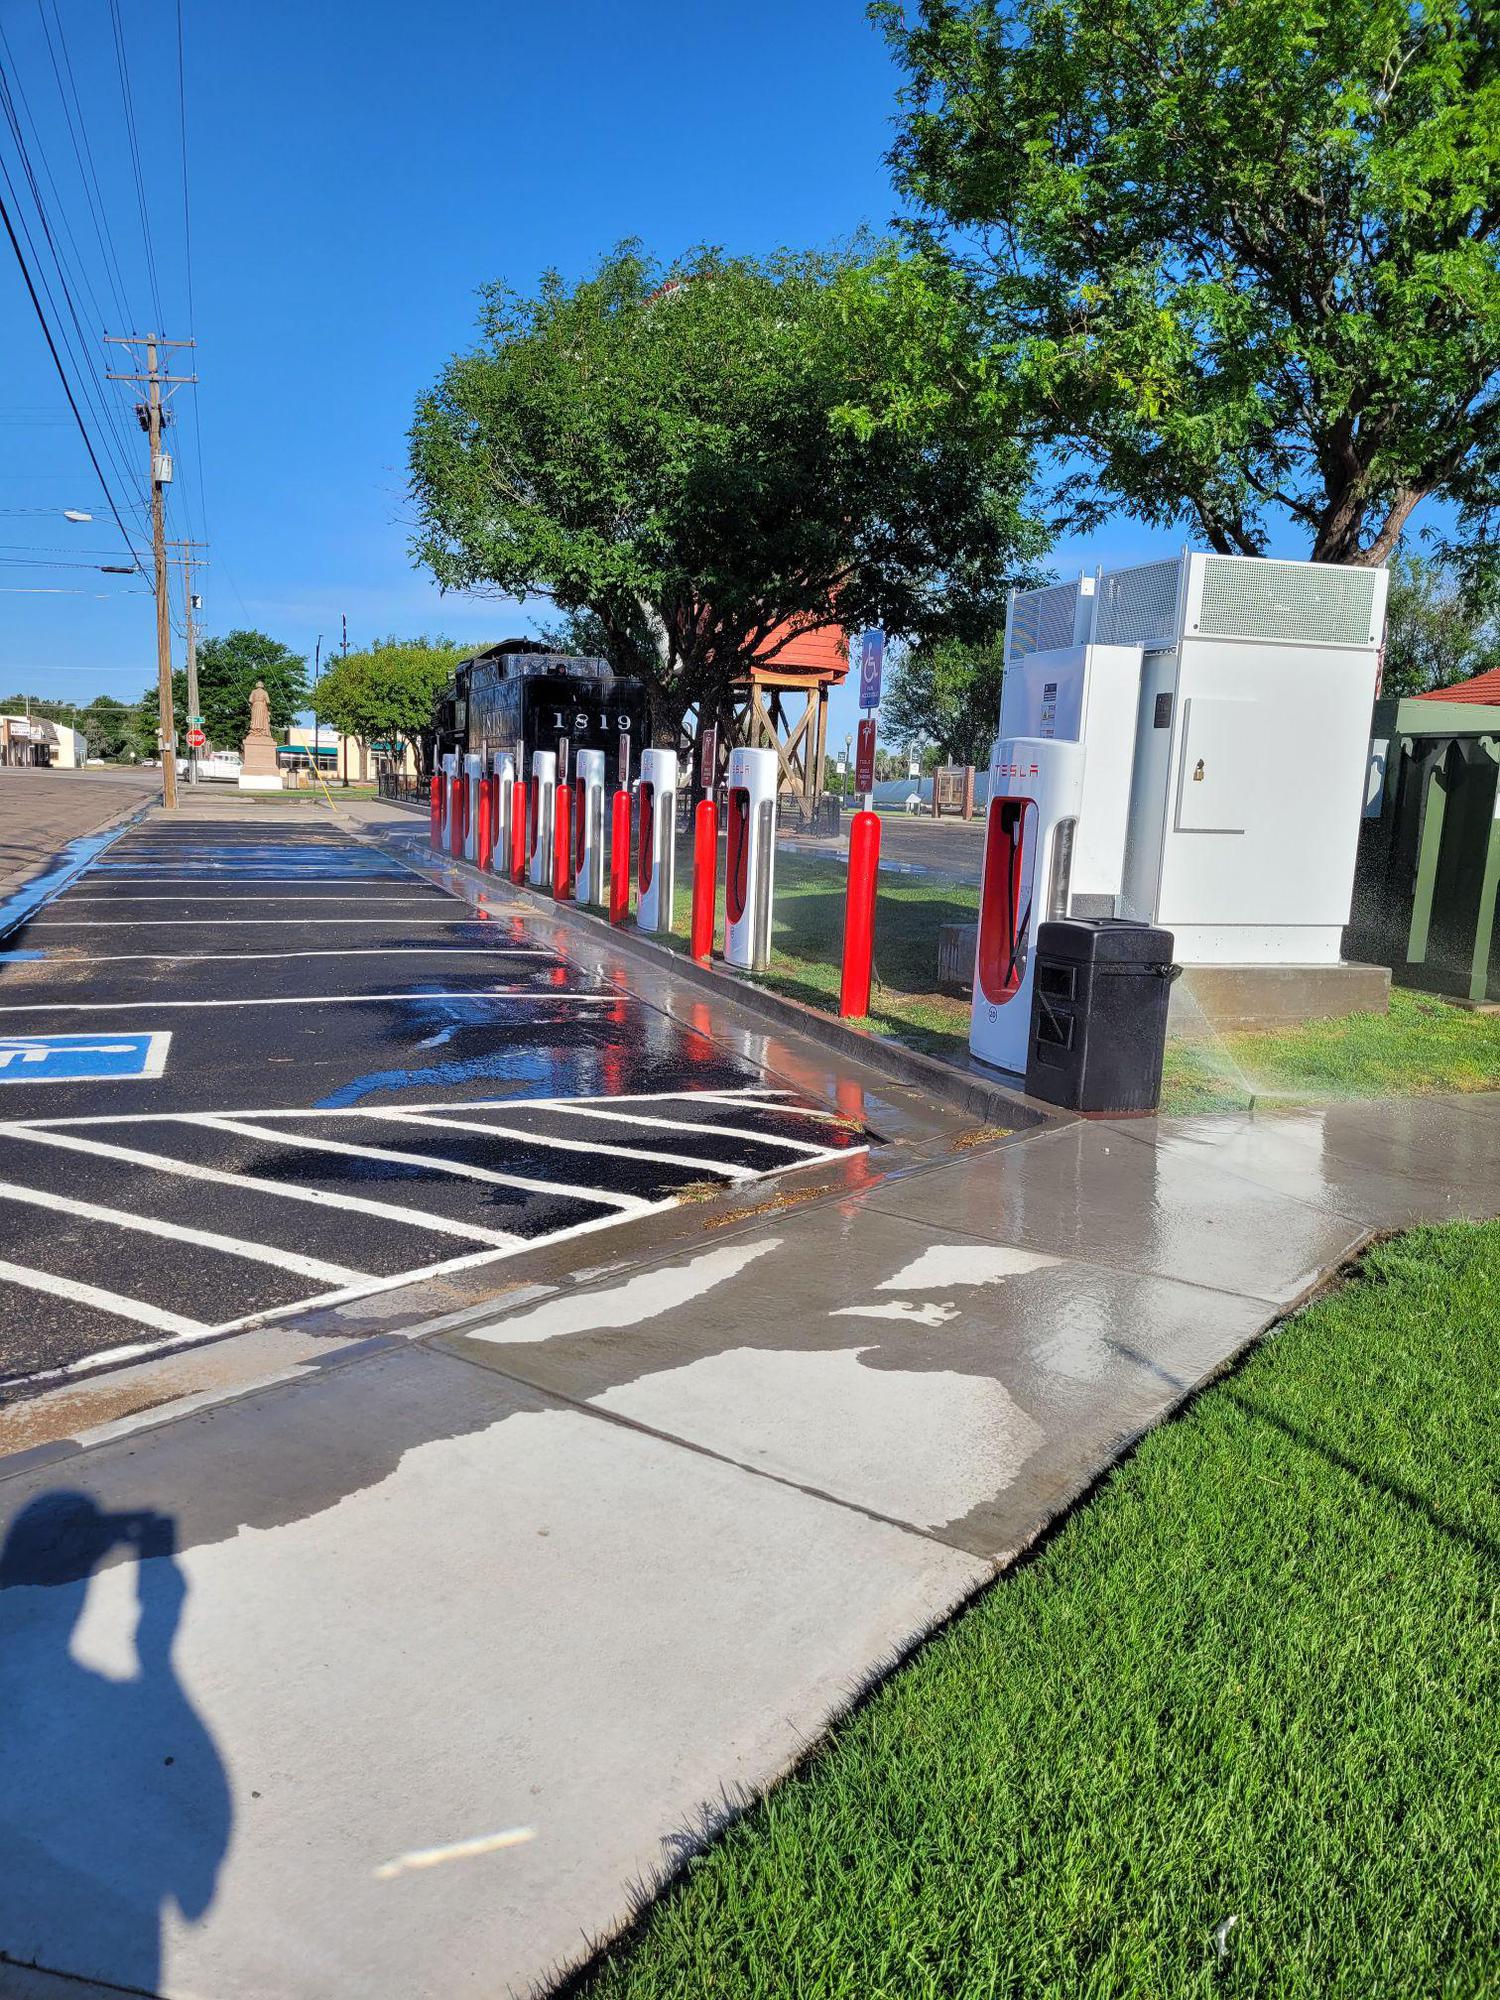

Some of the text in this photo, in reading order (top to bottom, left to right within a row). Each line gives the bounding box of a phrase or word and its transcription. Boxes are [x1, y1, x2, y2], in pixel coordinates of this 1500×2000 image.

[553, 712, 632, 730] 1819
[188, 734, 205, 742] STOP
[994, 764, 1040, 778] TESLA
